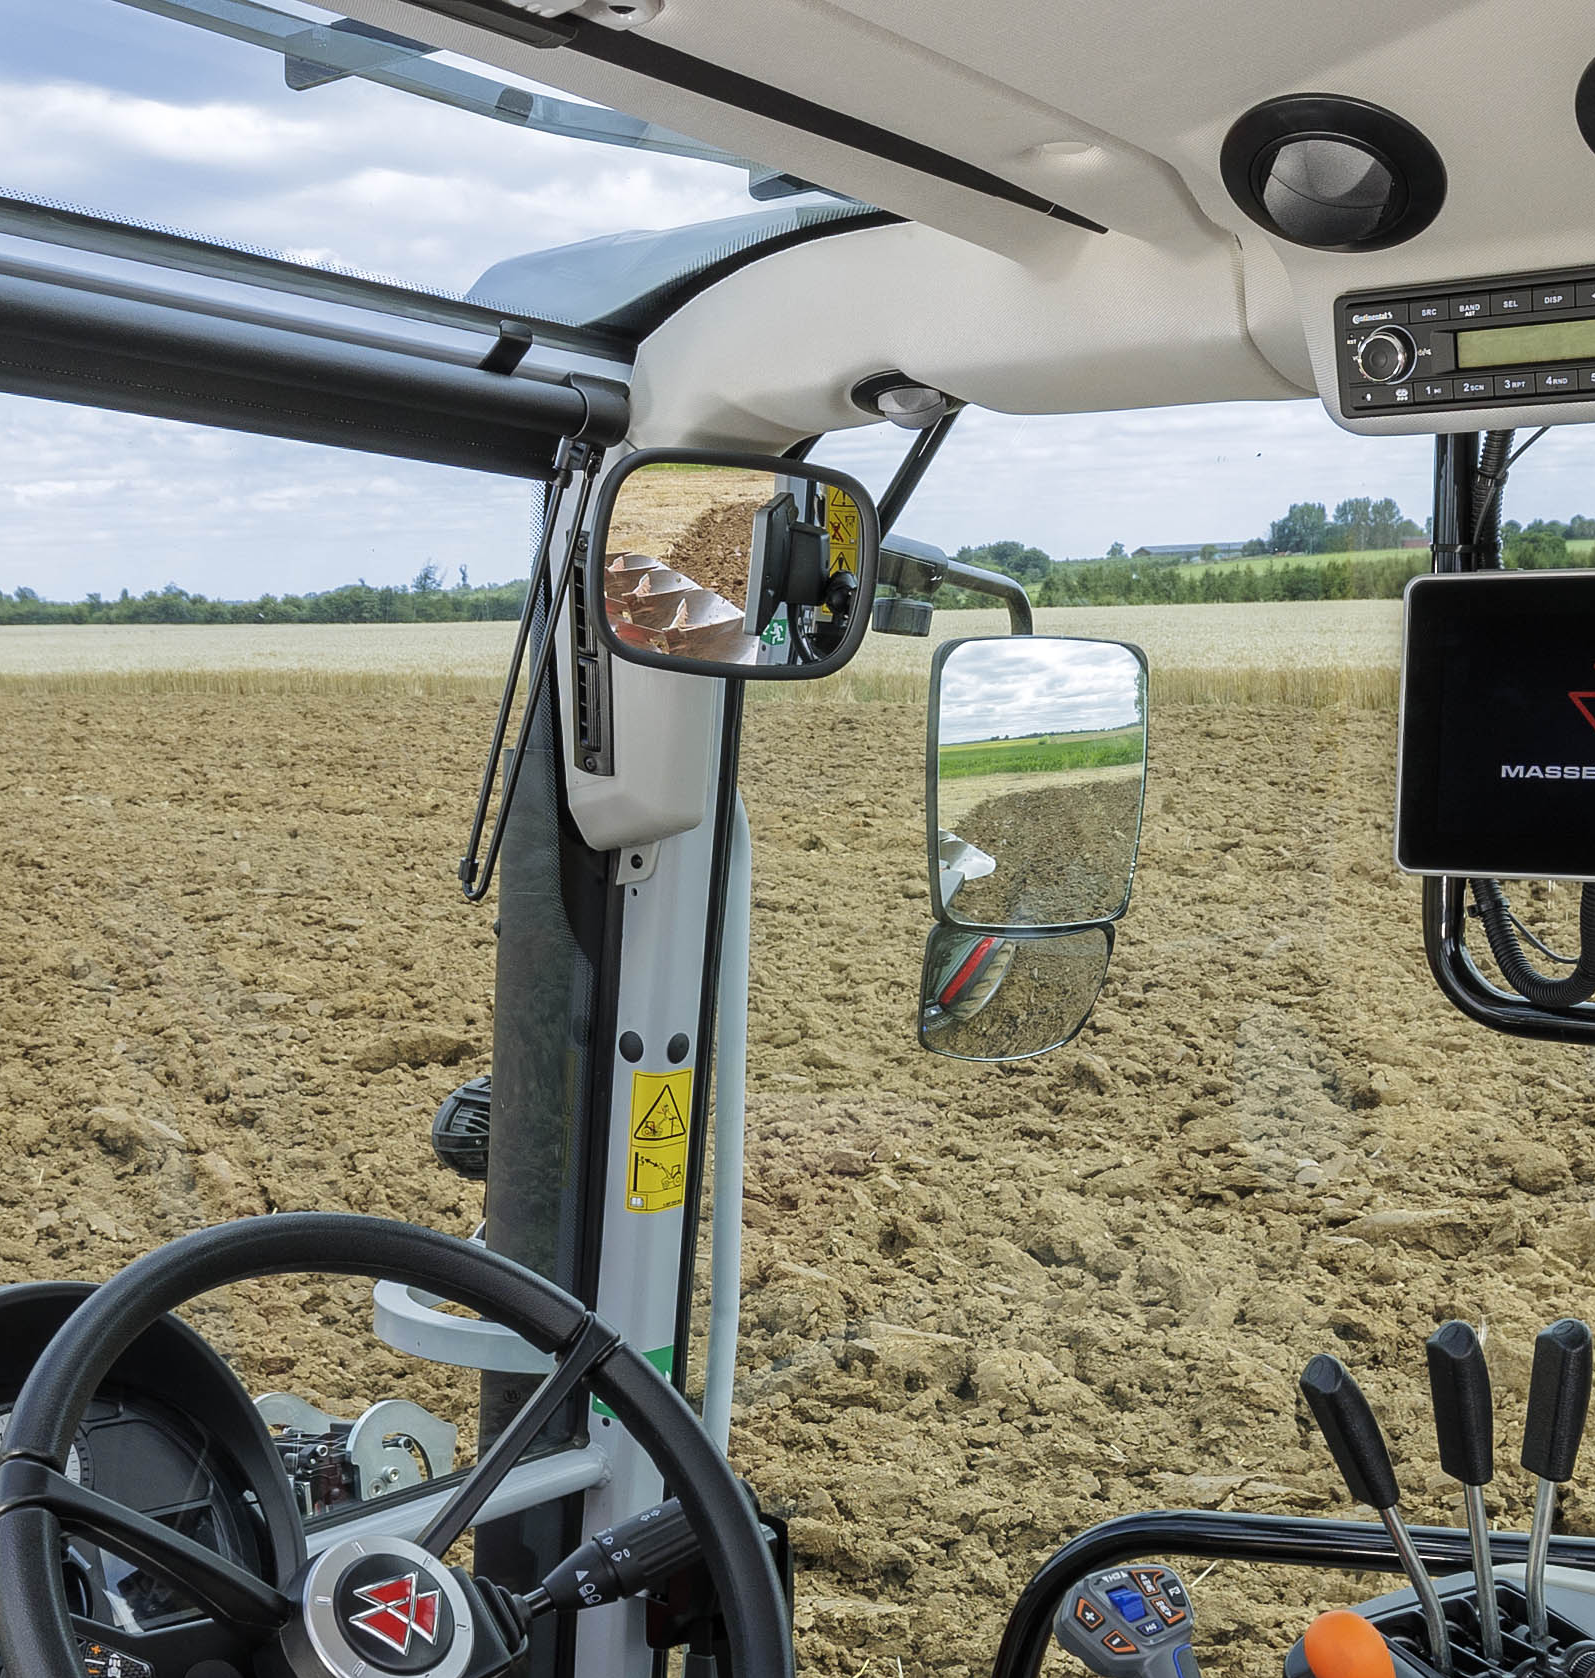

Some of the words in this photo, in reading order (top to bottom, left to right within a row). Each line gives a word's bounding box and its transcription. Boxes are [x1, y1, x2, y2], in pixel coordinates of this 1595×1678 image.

[1502, 300, 1519, 308] SEL
[1544, 295, 1563, 304] DISP
[1459, 303, 1481, 312] BAND
[1421, 308, 1437, 317] SRC
[1504, 379, 1511, 389] 3
[1425, 386, 1431, 395] 1
